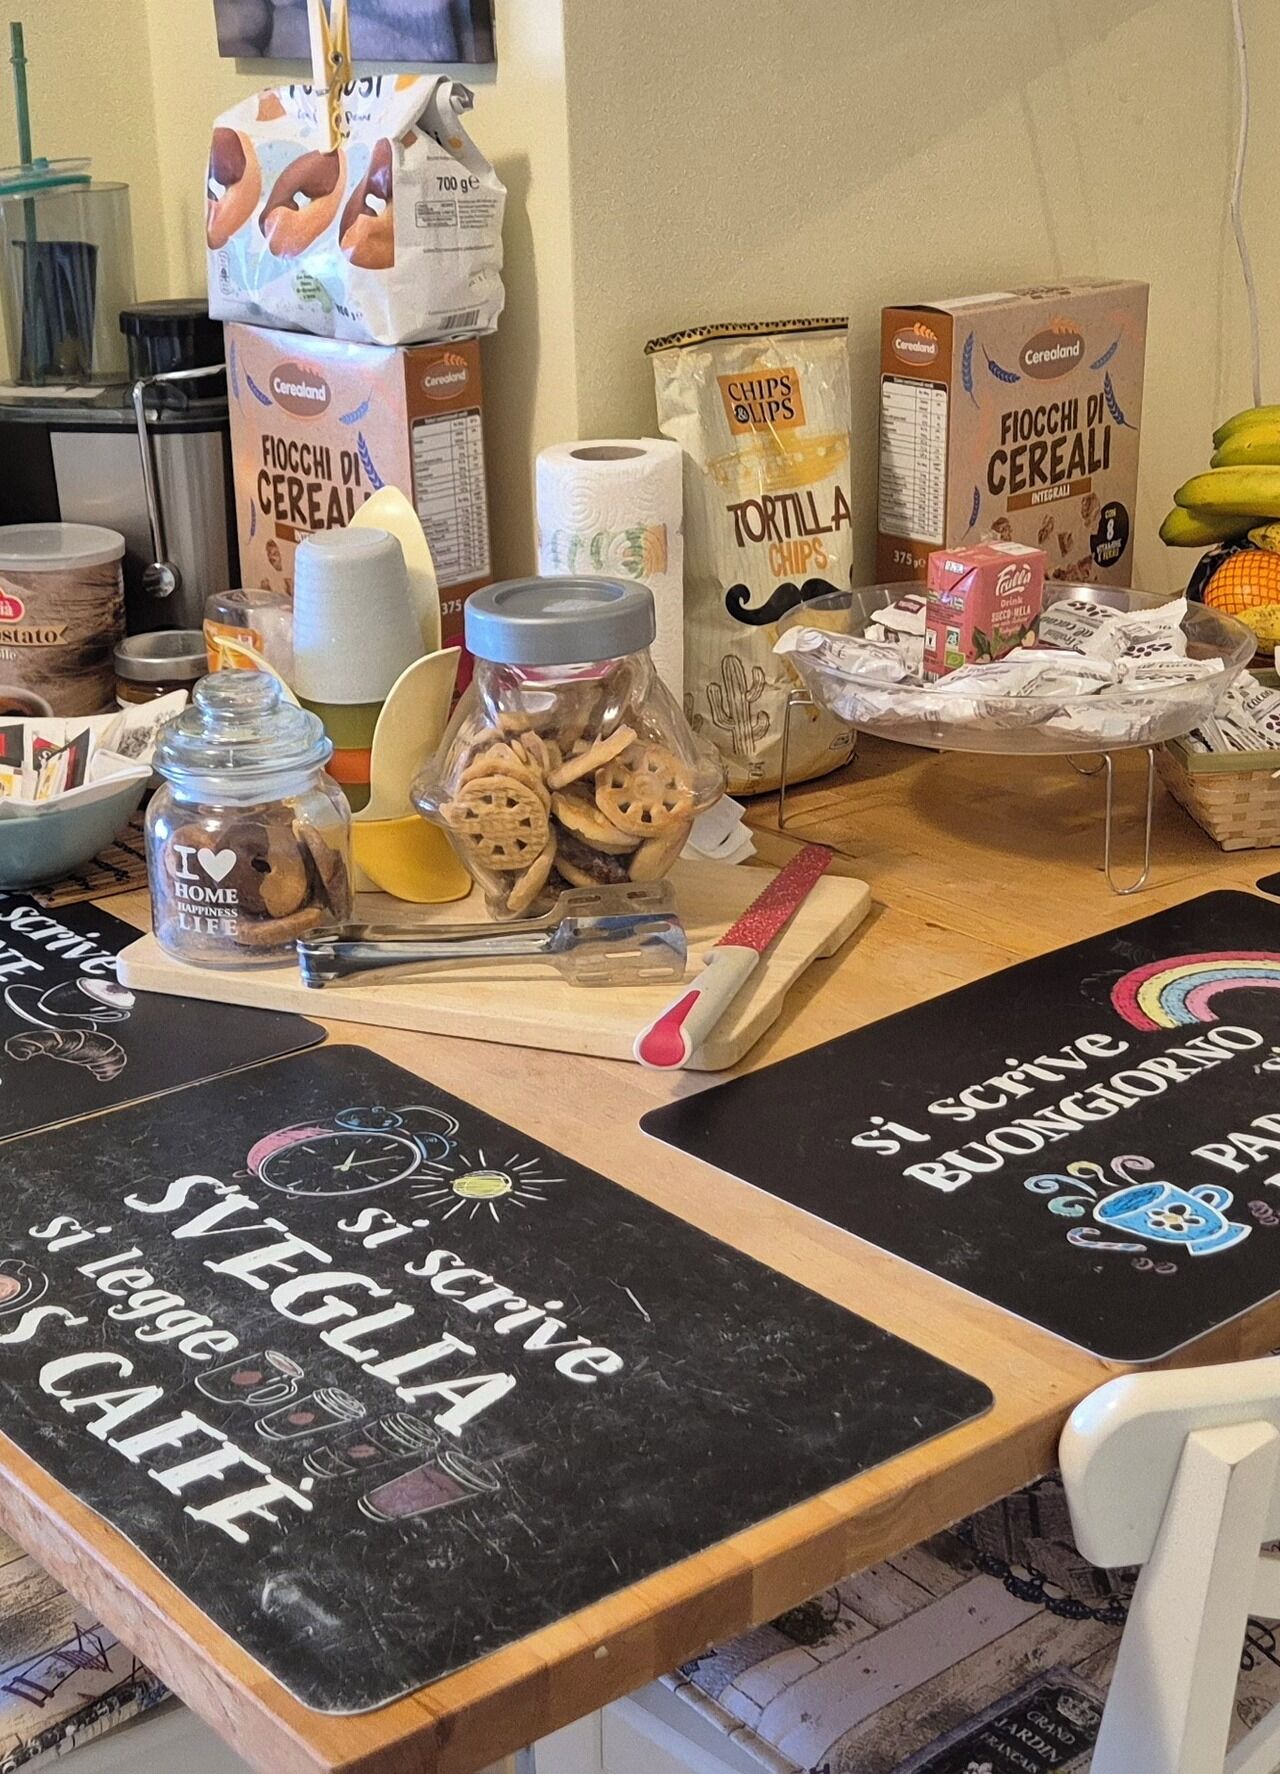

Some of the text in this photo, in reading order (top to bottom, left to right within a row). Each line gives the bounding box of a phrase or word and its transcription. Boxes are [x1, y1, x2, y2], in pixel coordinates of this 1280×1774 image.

[436, 177, 458, 191] 700
[895, 339, 935, 354] Cerealand
[1025, 341, 1080, 366] Cerealand
[273, 377, 326, 401] Cerealand
[425, 369, 467, 387] Cerealand
[728, 375, 792, 401] CHIPS
[1001, 392, 1105, 445] FIOCCHI DI
[261, 434, 360, 486] FIOCCHI DI
[987, 425, 1112, 495] CEREALI
[257, 469, 372, 530] CEREAL
[1031, 483, 1071, 505] INTEGRALI
[726, 485, 852, 548] TORTILLA
[1107, 519, 1114, 540] 8
[770, 537, 829, 577] CHIPS
[893, 550, 913, 566] 375
[441, 600, 463, 615] 375
[1001, 597, 1024, 608] Drink
[173, 844, 200, 880] I
[175, 881, 239, 904] HOME
[178, 902, 238, 917] HAPPINESS
[179, 913, 239, 936] LIFE
[0, 910, 118, 977] scrive
[851, 1033, 1130, 1157] si scrive
[903, 1025, 1265, 1193] BUONGIORNO
[28, 1213, 237, 1361] si legge
[336, 1206, 625, 1385] si scrive
[123, 1173, 516, 1438] SVEGLIA
[39, 1349, 316, 1545] CAFFÈ
[994, 1717, 1063, 1764] JARDIN
[1026, 1710, 1076, 1745] GRAND
